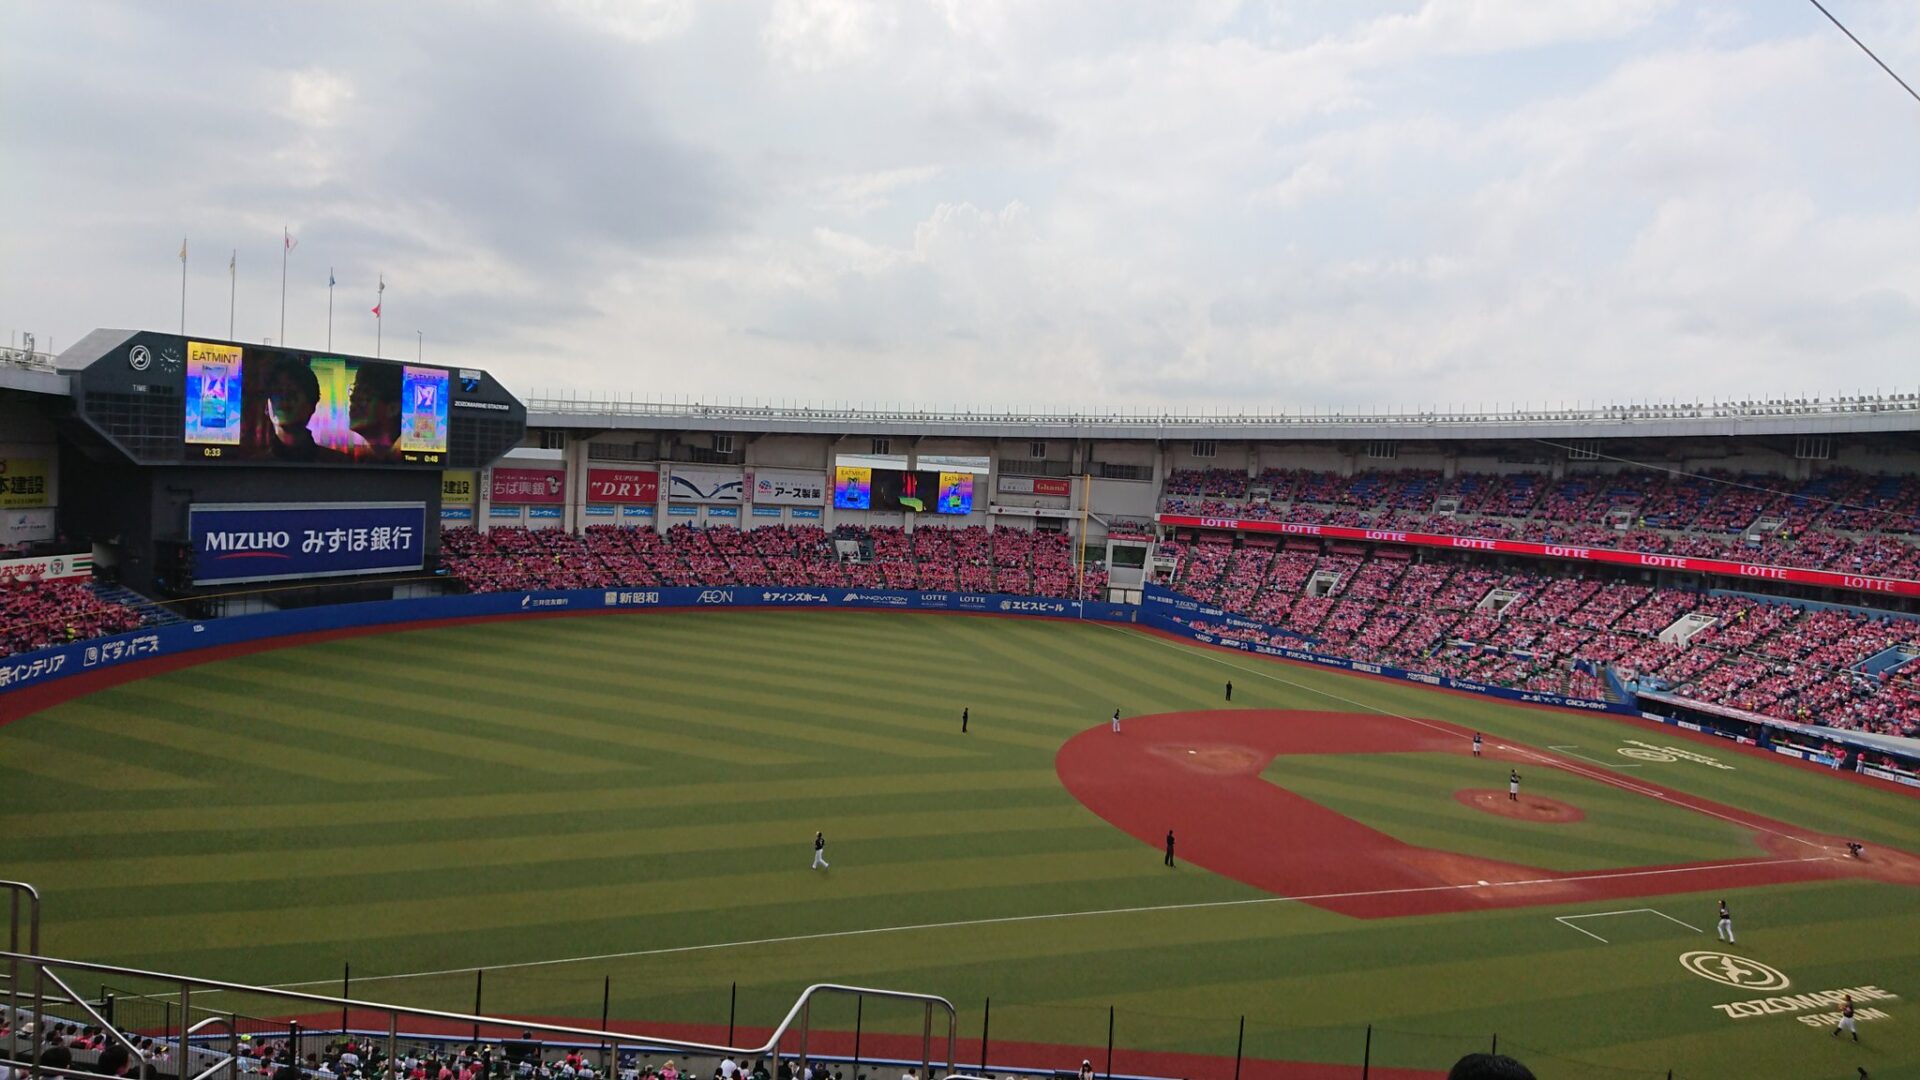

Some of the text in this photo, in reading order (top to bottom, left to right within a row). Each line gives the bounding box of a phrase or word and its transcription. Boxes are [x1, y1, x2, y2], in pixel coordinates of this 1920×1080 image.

[192, 350, 238, 363] EATMINT
[204, 448, 221, 456] 0:33
[1037, 483, 1065, 491] Ghana
[1200, 519, 1239, 528] LOTTE
[1281, 525, 1321, 535] LOTTE
[205, 526, 413, 553] MIZUHO みずほ銀行
[1365, 531, 1407, 542] LOTTE
[1452, 538, 1496, 549] LOTTE
[1545, 546, 1590, 559] LOTTE
[1641, 555, 1686, 568] LOTTE
[1740, 565, 1788, 579] LOTTE
[1844, 576, 1895, 592] LOTTE
[619, 592, 659, 603] 新昭和
[772, 593, 828, 601] アインズホーム
